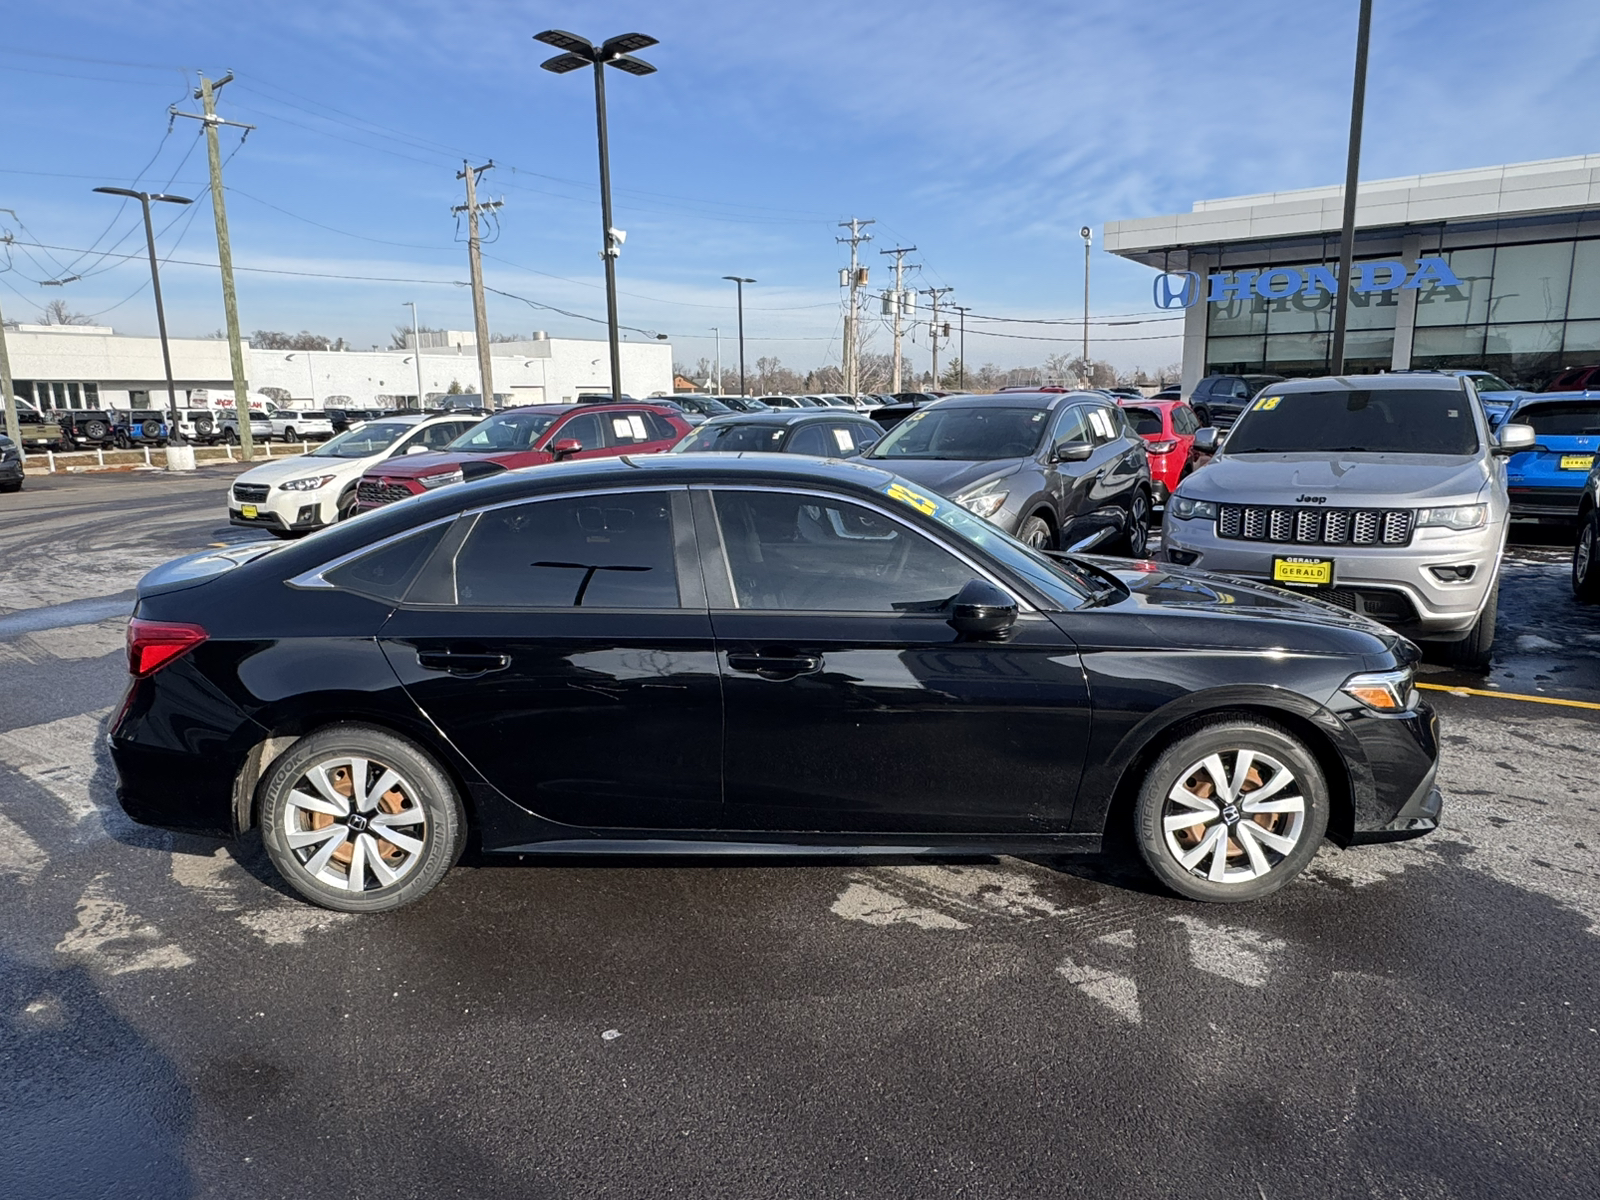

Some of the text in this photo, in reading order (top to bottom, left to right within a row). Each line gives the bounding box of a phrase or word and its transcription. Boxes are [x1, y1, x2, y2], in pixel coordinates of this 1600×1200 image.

[1207, 257, 1464, 302] HONDA
[1252, 397, 1281, 411] 18
[1295, 494, 1327, 504] Jeep
[1282, 567, 1323, 577] GERALD
